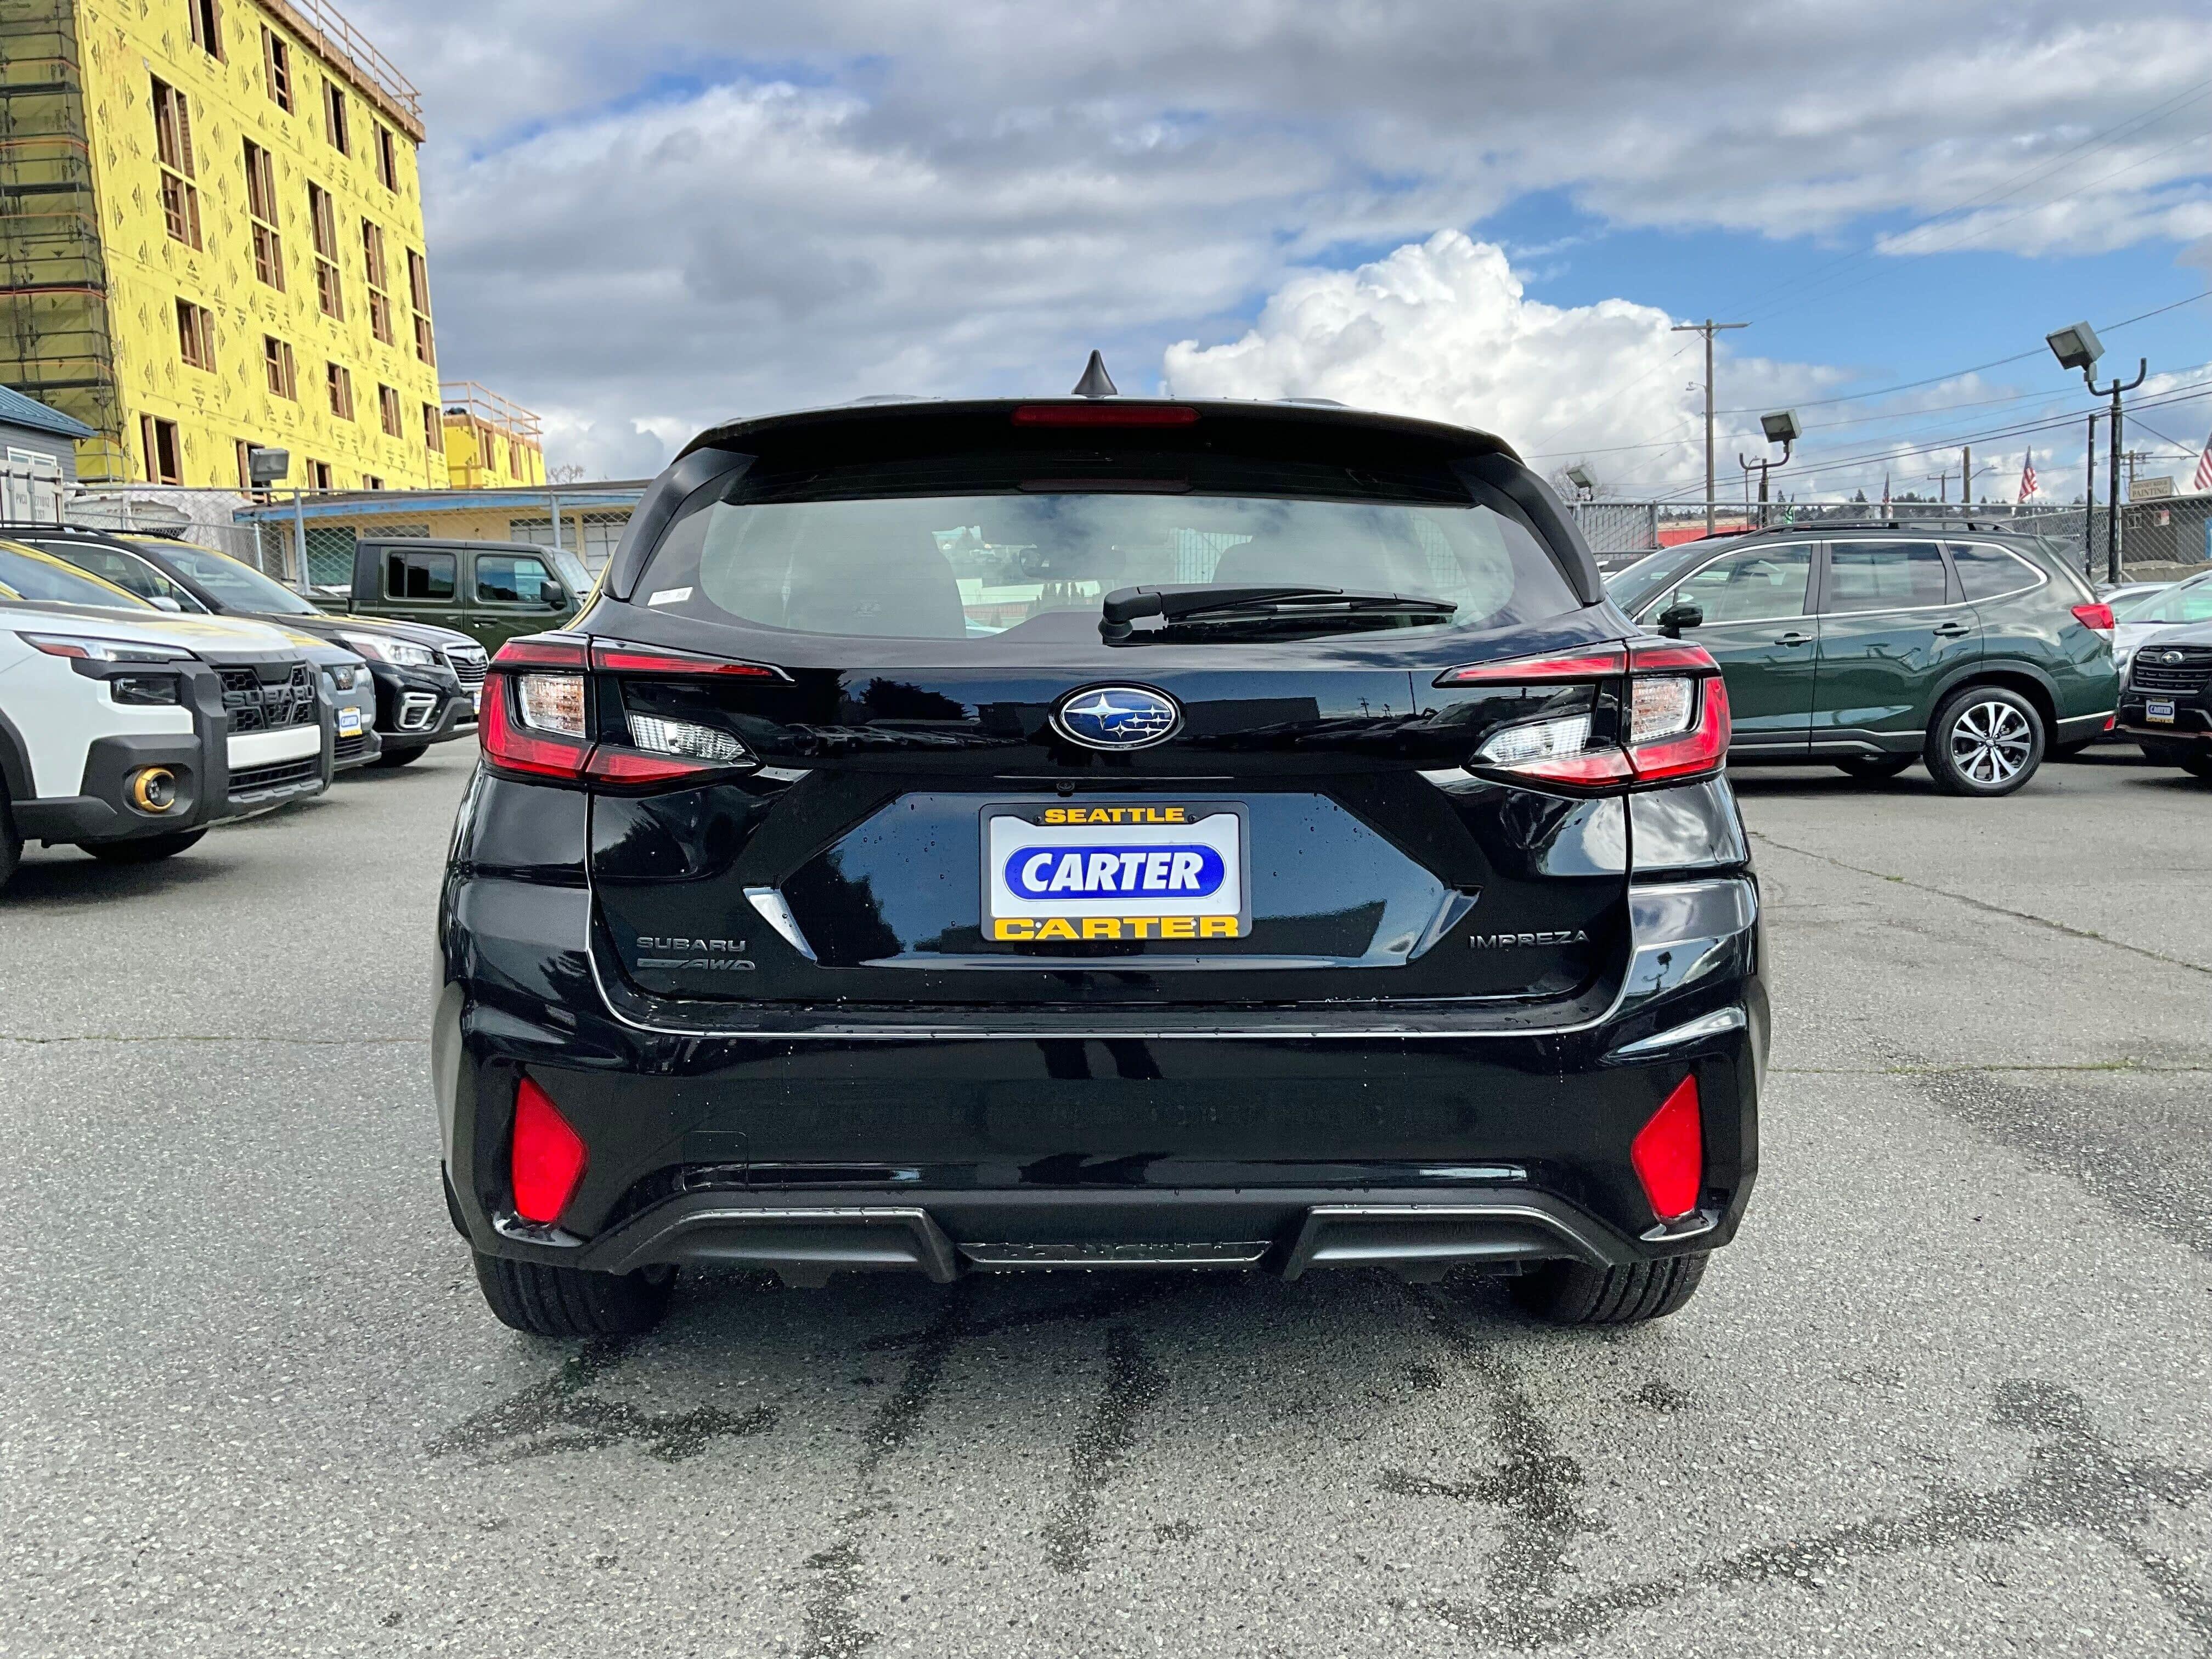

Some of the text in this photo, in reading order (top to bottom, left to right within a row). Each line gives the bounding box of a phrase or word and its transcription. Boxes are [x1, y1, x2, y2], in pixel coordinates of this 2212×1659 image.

[2132, 487, 2168, 498] PAINTING
[222, 685, 315, 708] SUBARU
[1045, 808, 1184, 823] SEATTLE
[1022, 852, 1204, 891] CARTER
[994, 917, 1238, 940] CARTER
[636, 937, 746, 952] SUBARU
[1469, 930, 1590, 949] IMPREZA
[680, 958, 755, 970] AWD
